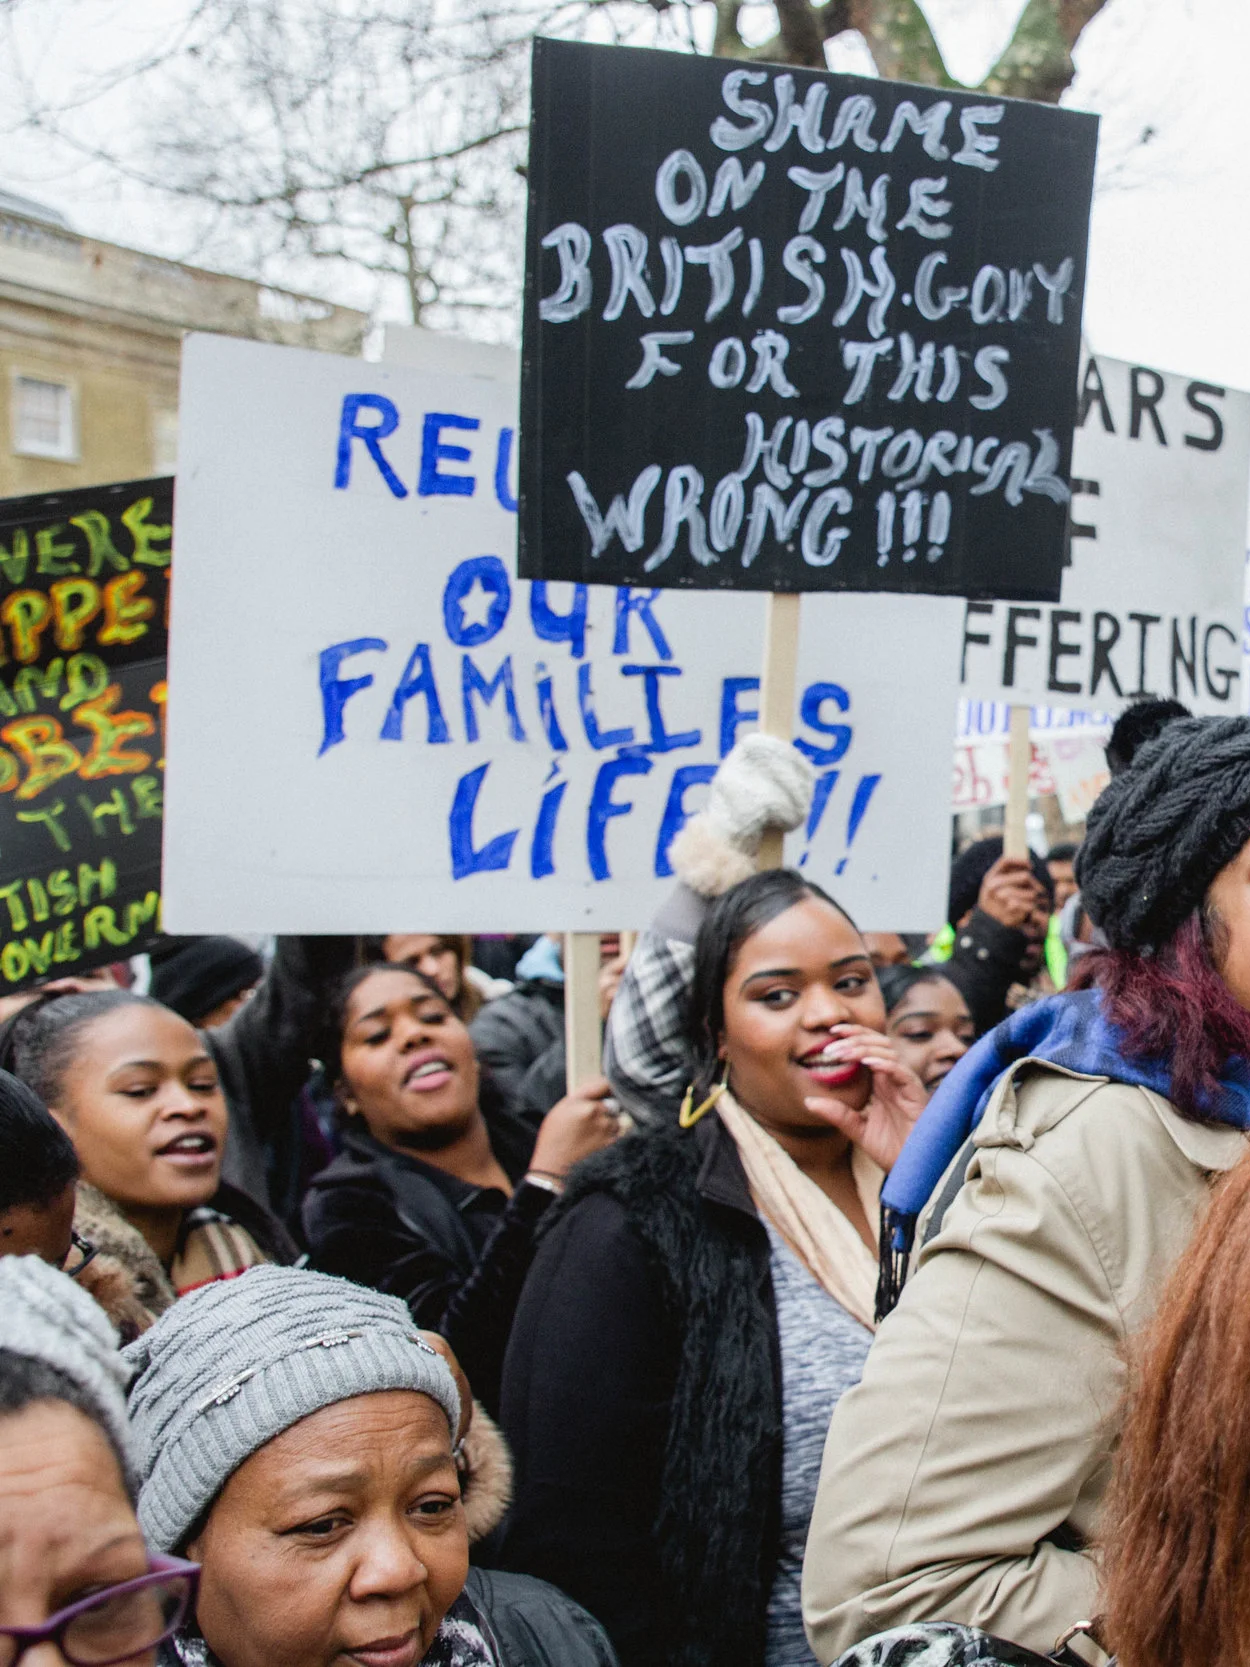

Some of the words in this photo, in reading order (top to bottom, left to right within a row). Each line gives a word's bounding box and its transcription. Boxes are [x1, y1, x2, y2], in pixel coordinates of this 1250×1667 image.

[710, 69, 1005, 172] SHAME
[656, 149, 766, 226] ON
[788, 161, 954, 243] THE
[625, 329, 800, 398] FOR
[842, 331, 1010, 411] THIS
[1074, 356, 1226, 451] ARS
[737, 412, 1072, 506] HISTORICAL
[0, 568, 171, 668] PPE
[443, 554, 674, 661] OUR
[960, 600, 1241, 701] FFERING
[15, 773, 164, 852] THE
[0, 890, 163, 983] OVERN
